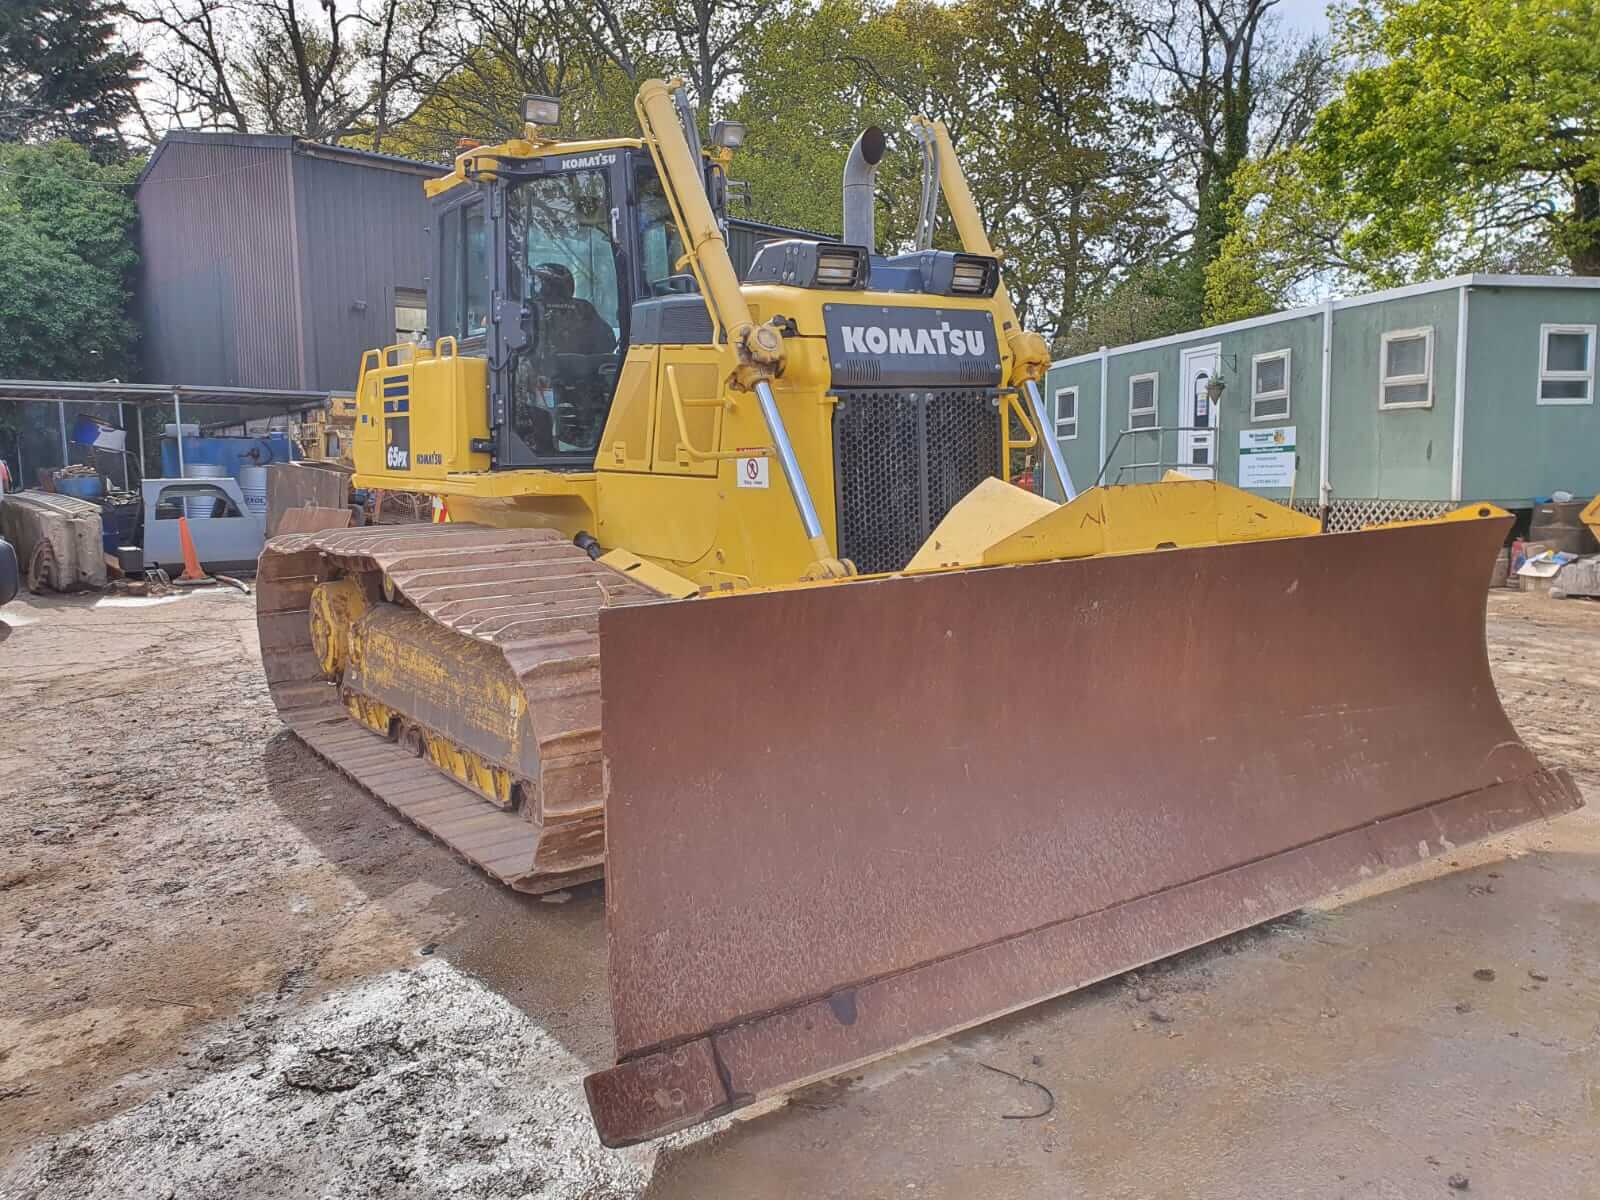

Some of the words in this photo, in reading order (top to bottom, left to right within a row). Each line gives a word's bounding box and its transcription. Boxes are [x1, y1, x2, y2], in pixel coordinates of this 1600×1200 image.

[561, 153, 616, 169] KOMATSU
[841, 322, 985, 356] KOMATSU
[388, 446, 408, 467] 65PX
[416, 451, 442, 465] KOMATSU
